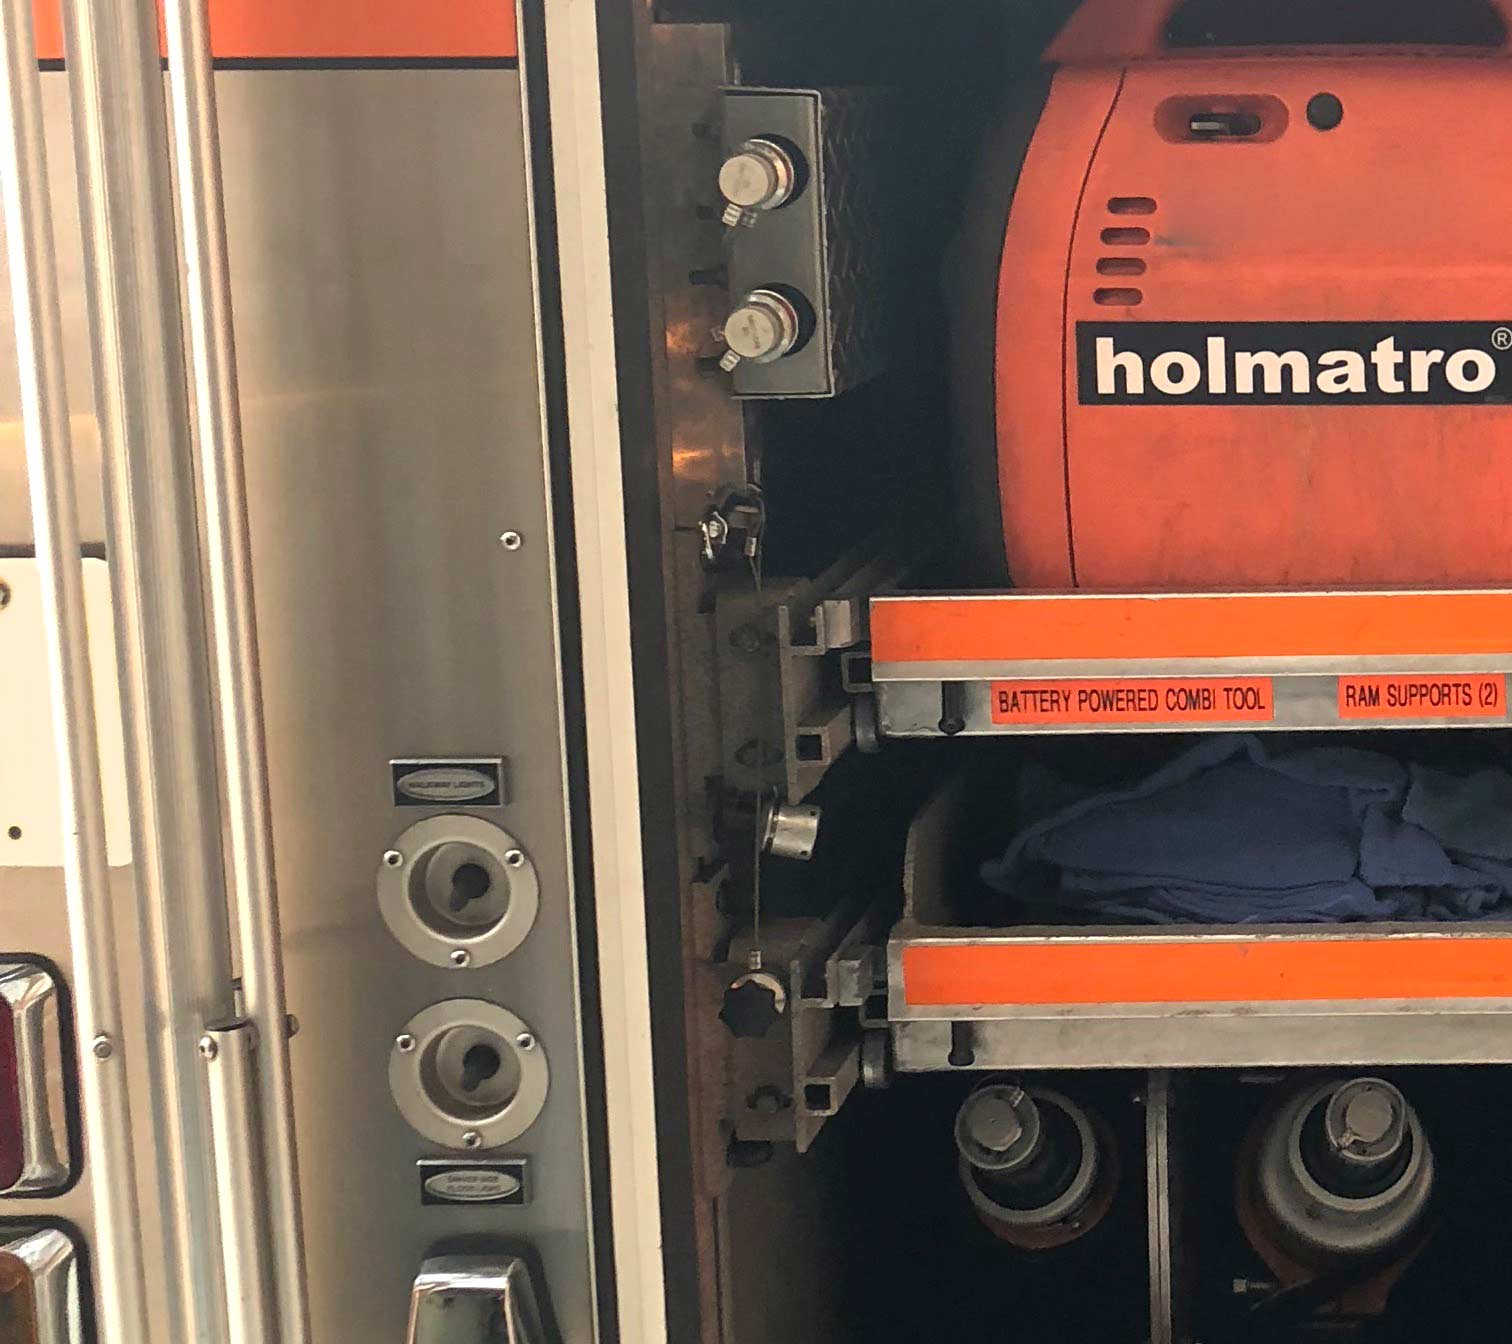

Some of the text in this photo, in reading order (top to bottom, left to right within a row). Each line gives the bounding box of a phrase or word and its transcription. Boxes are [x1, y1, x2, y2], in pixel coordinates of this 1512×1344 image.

[999, 687, 1266, 713] BATTERY POWERED COMBI TOOL
[1345, 682, 1498, 708] RAM SUPPORTS (2)
